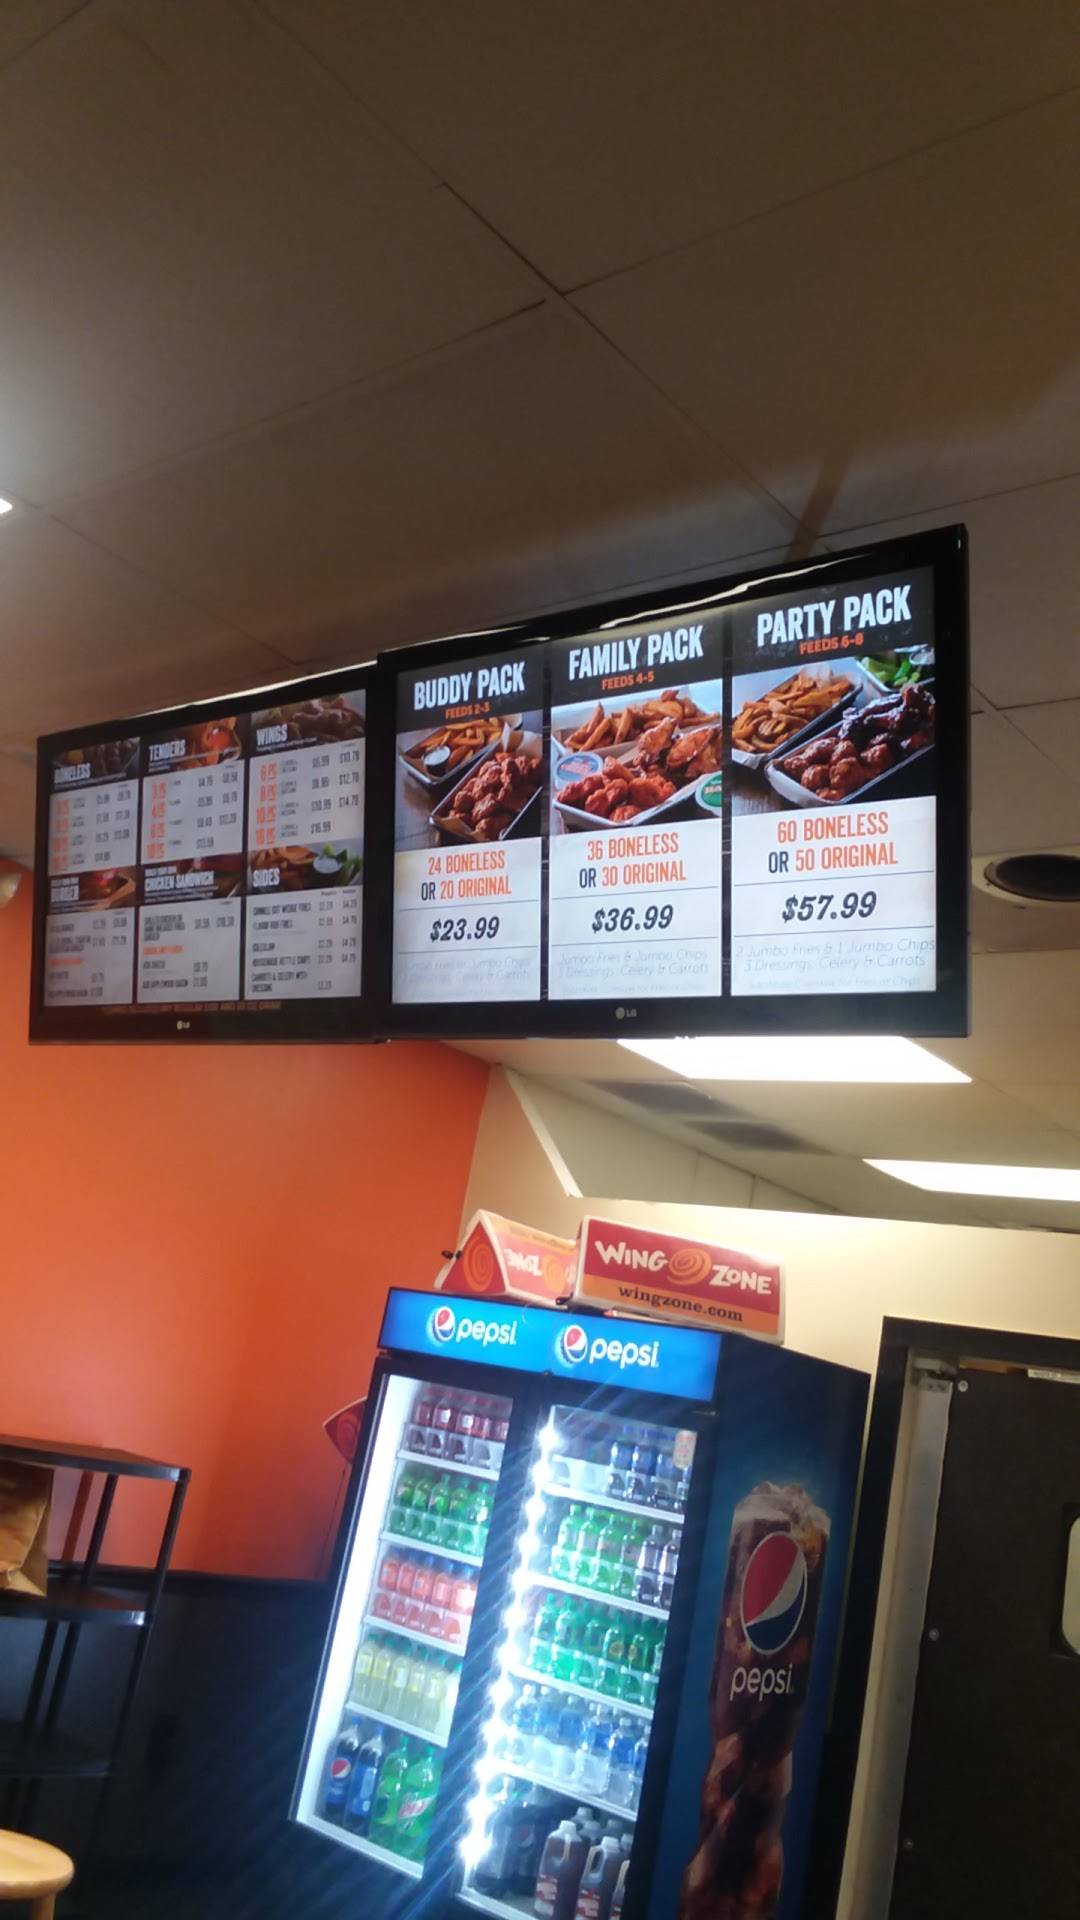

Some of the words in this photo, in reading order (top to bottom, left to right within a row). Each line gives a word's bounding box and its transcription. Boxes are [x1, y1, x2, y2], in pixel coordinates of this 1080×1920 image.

[757, 600, 835, 647] PARTY
[844, 585, 911, 631] PACK
[569, 637, 641, 680] FAMILY
[648, 625, 703, 666] PACK
[800, 636, 838, 655] FEEDS
[841, 632, 864, 647] 6-8
[414, 672, 472, 710] BUDDY
[477, 661, 525, 698] PACK
[602, 675, 634, 690] FEEDS
[636, 671, 654, 684] 4-5
[445, 705, 473, 719] FEEDS
[474, 701, 490, 713] 2-3
[256, 724, 288, 746] WINGS
[777, 820, 797, 843] 60
[803, 811, 889, 841] BONELESS
[587, 840, 603, 861] 36
[608, 832, 679, 859] BONELESS
[768, 851, 789, 873] OR
[795, 848, 815, 871] 50
[821, 842, 898, 870] ORIGINAL
[428, 857, 441, 875] 24
[446, 850, 505, 873] BONELESS
[579, 868, 596, 888] OR
[602, 865, 618, 886] 30
[623, 860, 687, 885] ORIGINAL
[253, 868, 280, 887] SIDES
[421, 882, 436, 901] OR
[440, 880, 454, 899] 20
[458, 875, 512, 897] ORIGINAL
[592, 904, 674, 934] $36.99
[782, 891, 877, 924] $57.99
[430, 916, 500, 942] $23.99
[595, 1241, 668, 1271] WING
[709, 1264, 772, 1295] ZONE
[618, 1286, 743, 1322] wingzone.com
[456, 1318, 518, 1347] pepsi
[589, 1338, 660, 1369] pepsi
[730, 1662, 793, 1702] pepsi
